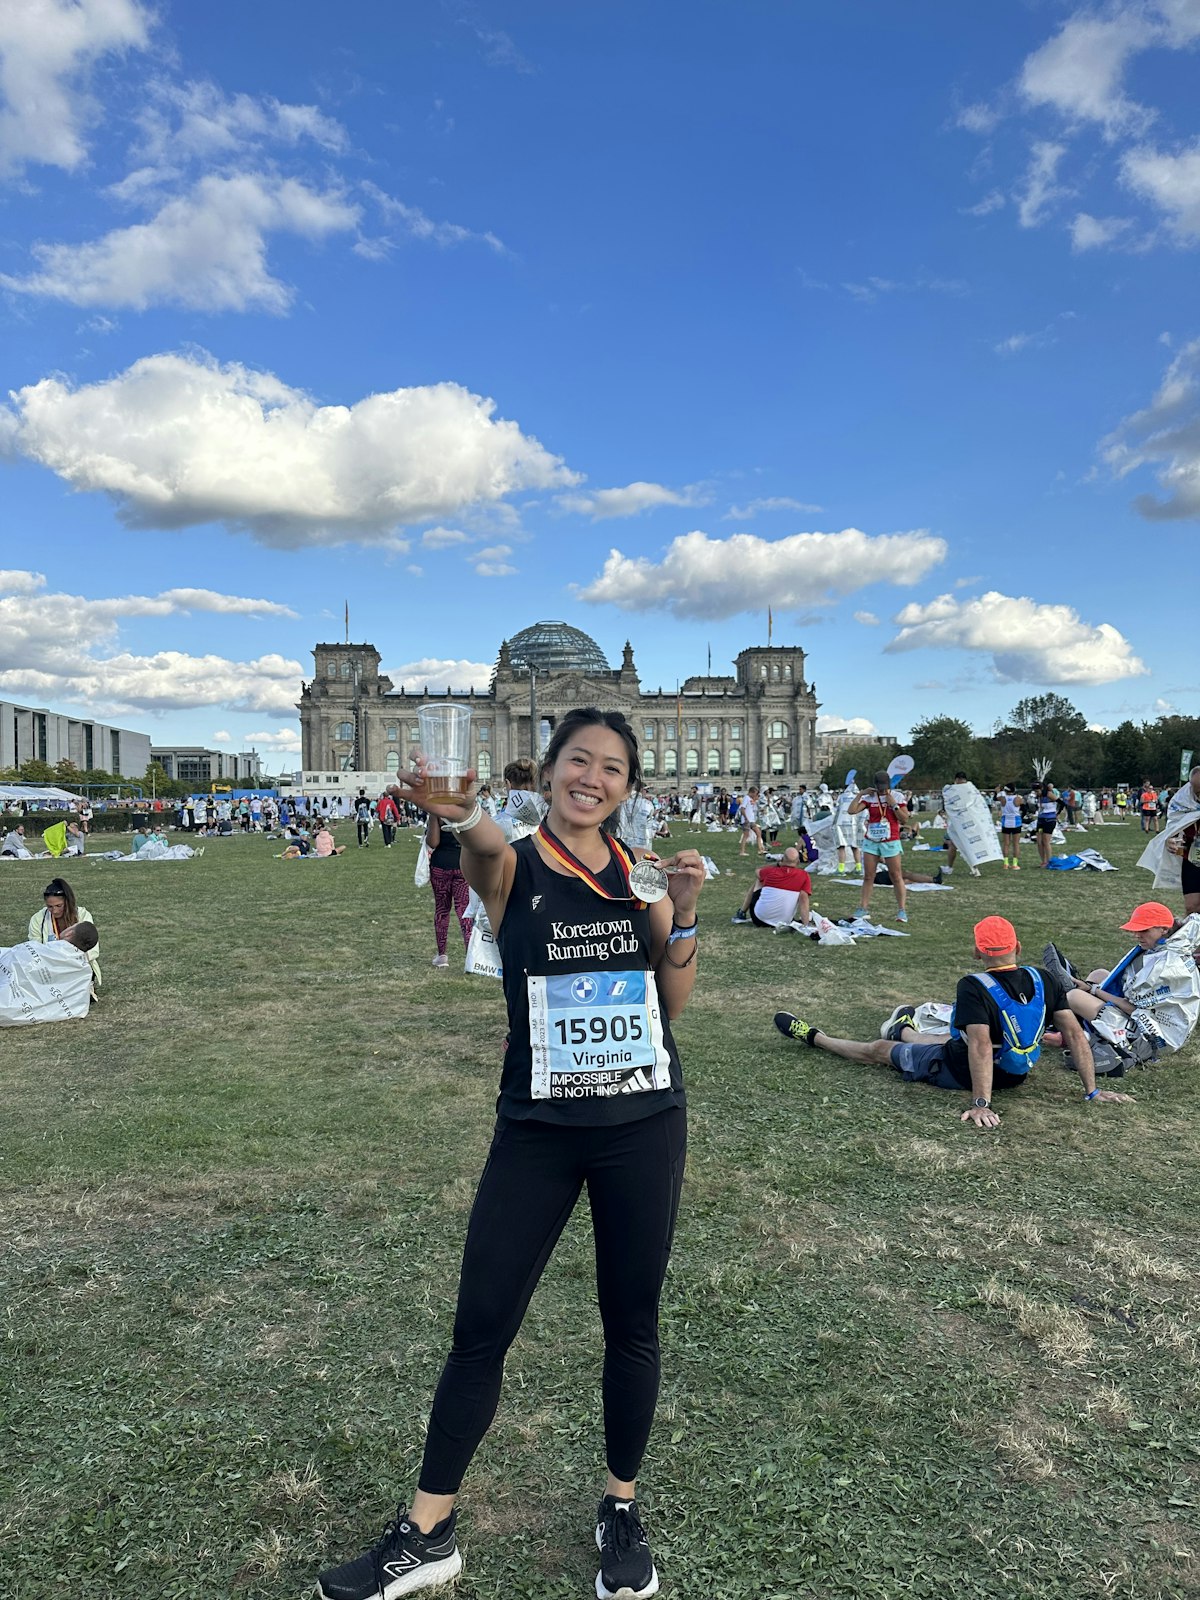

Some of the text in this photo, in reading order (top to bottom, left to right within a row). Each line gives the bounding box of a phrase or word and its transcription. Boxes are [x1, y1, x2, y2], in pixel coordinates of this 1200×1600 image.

[551, 919, 633, 940] Koreatown
[546, 933, 639, 961] Running Club
[474, 962, 497, 974] BMW
[555, 1015, 643, 1045] 15905
[1140, 1013, 1159, 1037] BMW
[573, 1049, 632, 1068] Virginia
[552, 1071, 621, 1086] IMPOSSIBLE
[552, 1083, 619, 1098] IS NOTHING
